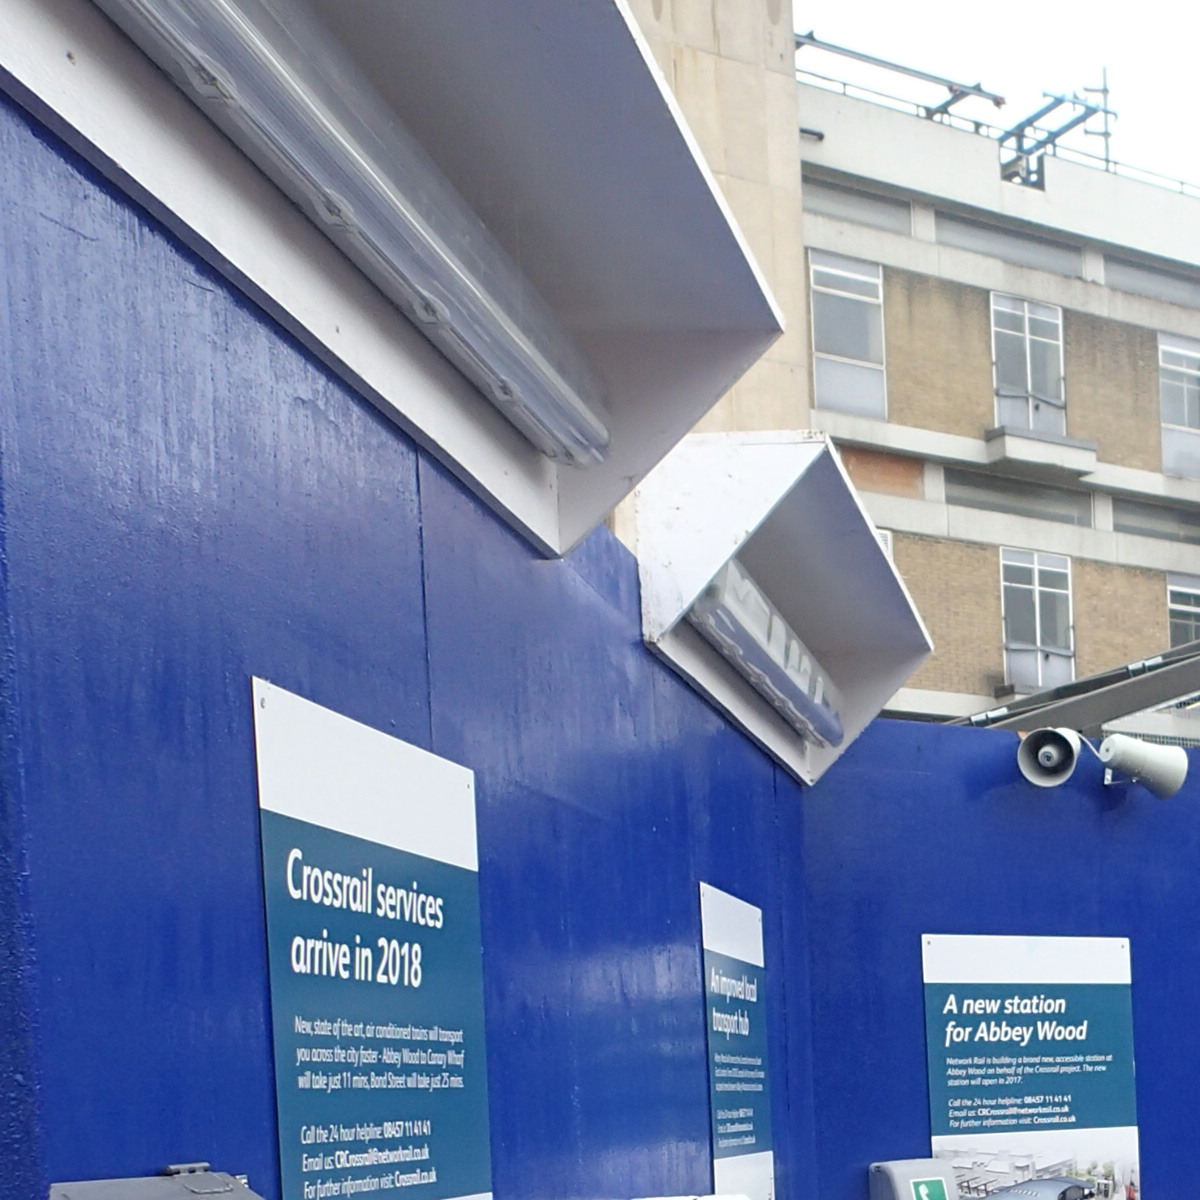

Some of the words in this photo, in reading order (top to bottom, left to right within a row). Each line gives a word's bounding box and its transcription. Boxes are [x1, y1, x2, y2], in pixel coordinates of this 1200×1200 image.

[287, 848, 372, 914] Crossrail
[376, 881, 444, 929] services
[291, 929, 350, 979] arrive
[355, 935, 372, 981] in
[376, 937, 422, 988] 2018
[943, 994, 957, 1014] A
[962, 999, 1000, 1014] new
[1004, 995, 1066, 1014] station
[712, 1006, 738, 1040] transport
[738, 1008, 750, 1036] hub
[945, 1021, 972, 1047] for
[974, 1021, 1033, 1046] Abbey
[1037, 1020, 1088, 1041] Wood
[296, 1048, 311, 1066] you
[311, 1048, 333, 1062] across
[334, 1045, 346, 1062] the
[347, 1046, 359, 1067] city
[359, 1045, 378, 1067] faster
[382, 1047, 401, 1068] Abbey
[402, 1047, 420, 1064] Wood
[420, 1050, 427, 1065] to
[301, 1125, 315, 1144] Call
[316, 1125, 328, 1143] the
[329, 1124, 339, 1142] 24
[340, 1123, 355, 1141] hour
[405, 1120, 413, 1137] 11
[414, 1120, 422, 1136] 41
[423, 1119, 431, 1136] 41
